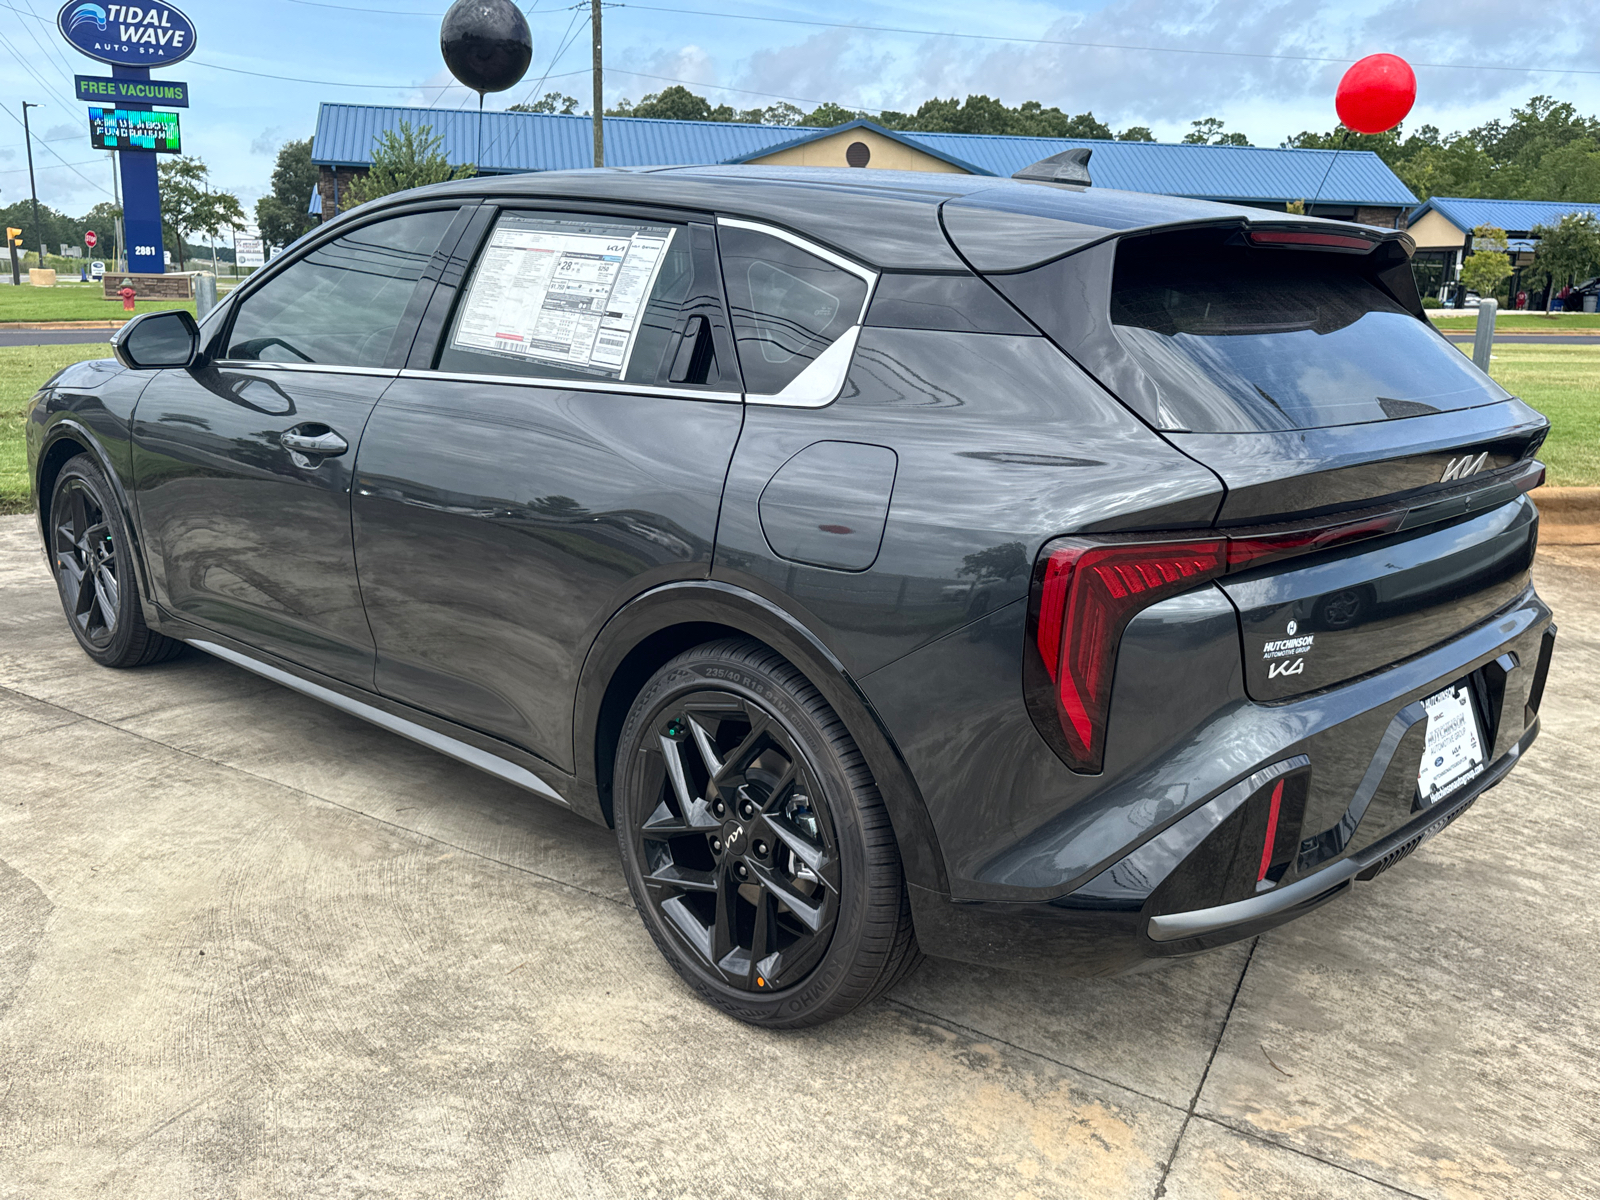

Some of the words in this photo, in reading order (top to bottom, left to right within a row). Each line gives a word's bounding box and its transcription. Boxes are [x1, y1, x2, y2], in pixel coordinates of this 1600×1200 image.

[108, 4, 172, 28] TIDAL
[119, 25, 185, 48] WAVE
[94, 42, 129, 52] AUTO
[139, 47, 164, 56] SPA
[80, 81, 116, 95] FREE
[119, 83, 183, 99] VACUUMS
[86, 235, 97, 243] STOP
[135, 245, 156, 256] 2881
[561, 261, 573, 271] 28
[1440, 451, 1489, 484] KIA
[1263, 635, 1314, 652] HUTCHINSON
[1263, 648, 1296, 659] AUTOMOTIVE
[1295, 645, 1311, 654] GROUP
[1268, 657, 1304, 679] K4
[706, 667, 740, 682] 235/40
[742, 676, 764, 693] R18
[765, 691, 790, 714] 91W
[1433, 712, 1444, 721] GMC
[1428, 712, 1467, 747] HUTCHINSON
[1430, 736, 1454, 755] AUTOMOTIVE
[1451, 744, 1461, 755] KIA
[788, 958, 842, 1013] KUMHO
